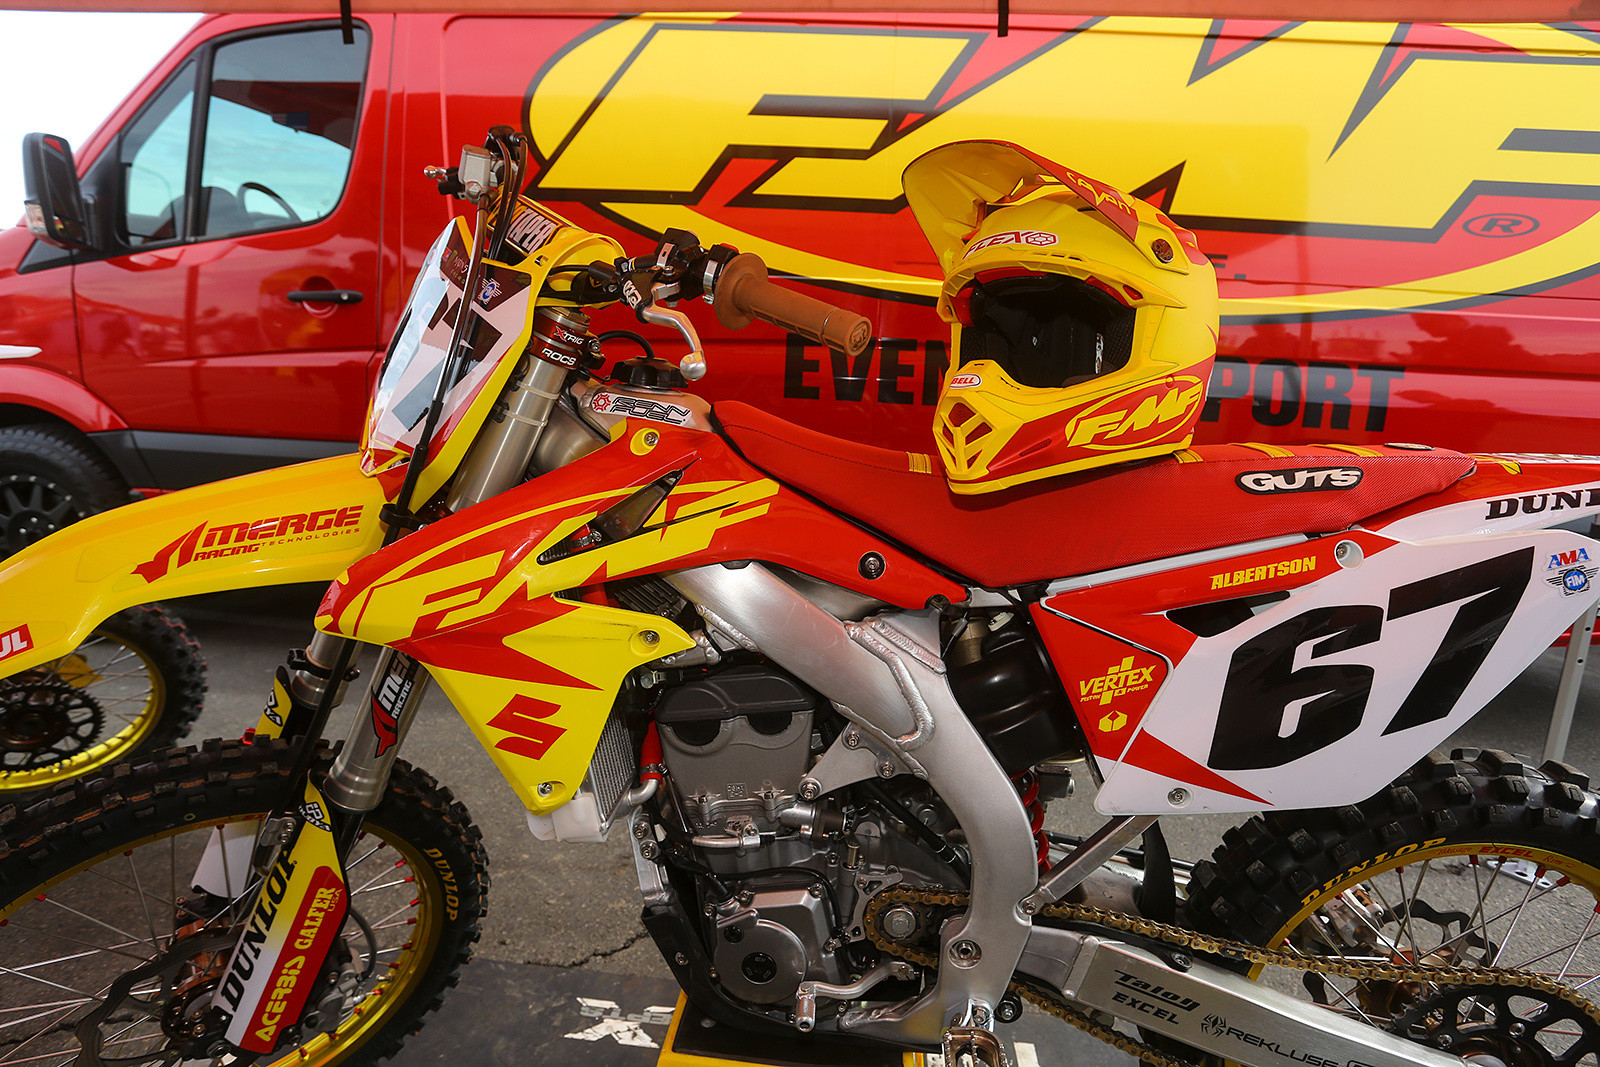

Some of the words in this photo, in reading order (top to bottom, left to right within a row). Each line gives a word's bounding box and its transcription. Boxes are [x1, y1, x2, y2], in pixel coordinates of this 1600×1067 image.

[541, 347, 577, 366] ROCS
[951, 376, 975, 385] BELL
[1066, 382, 1202, 448] FMF
[1240, 467, 1361, 492] GUTS
[201, 505, 364, 548] MERGE
[193, 543, 260, 562] RACING
[260, 527, 360, 546] TECHNOLOGIES
[1547, 548, 1590, 569] AMA
[1210, 556, 1317, 590] ALBERTSON
[1566, 574, 1585, 587] FIM
[1207, 545, 1535, 771] 67
[1079, 665, 1157, 696] VERTEX
[1478, 846, 1534, 858] EXCEL
[423, 848, 460, 922] DUNLOP
[1301, 836, 1447, 906] DUNLOP
[326, 888, 343, 912] USA
[294, 886, 336, 950] GALFER
[1111, 991, 1180, 1025] EXCEL
[1226, 1029, 1340, 1067] REKLUSE
